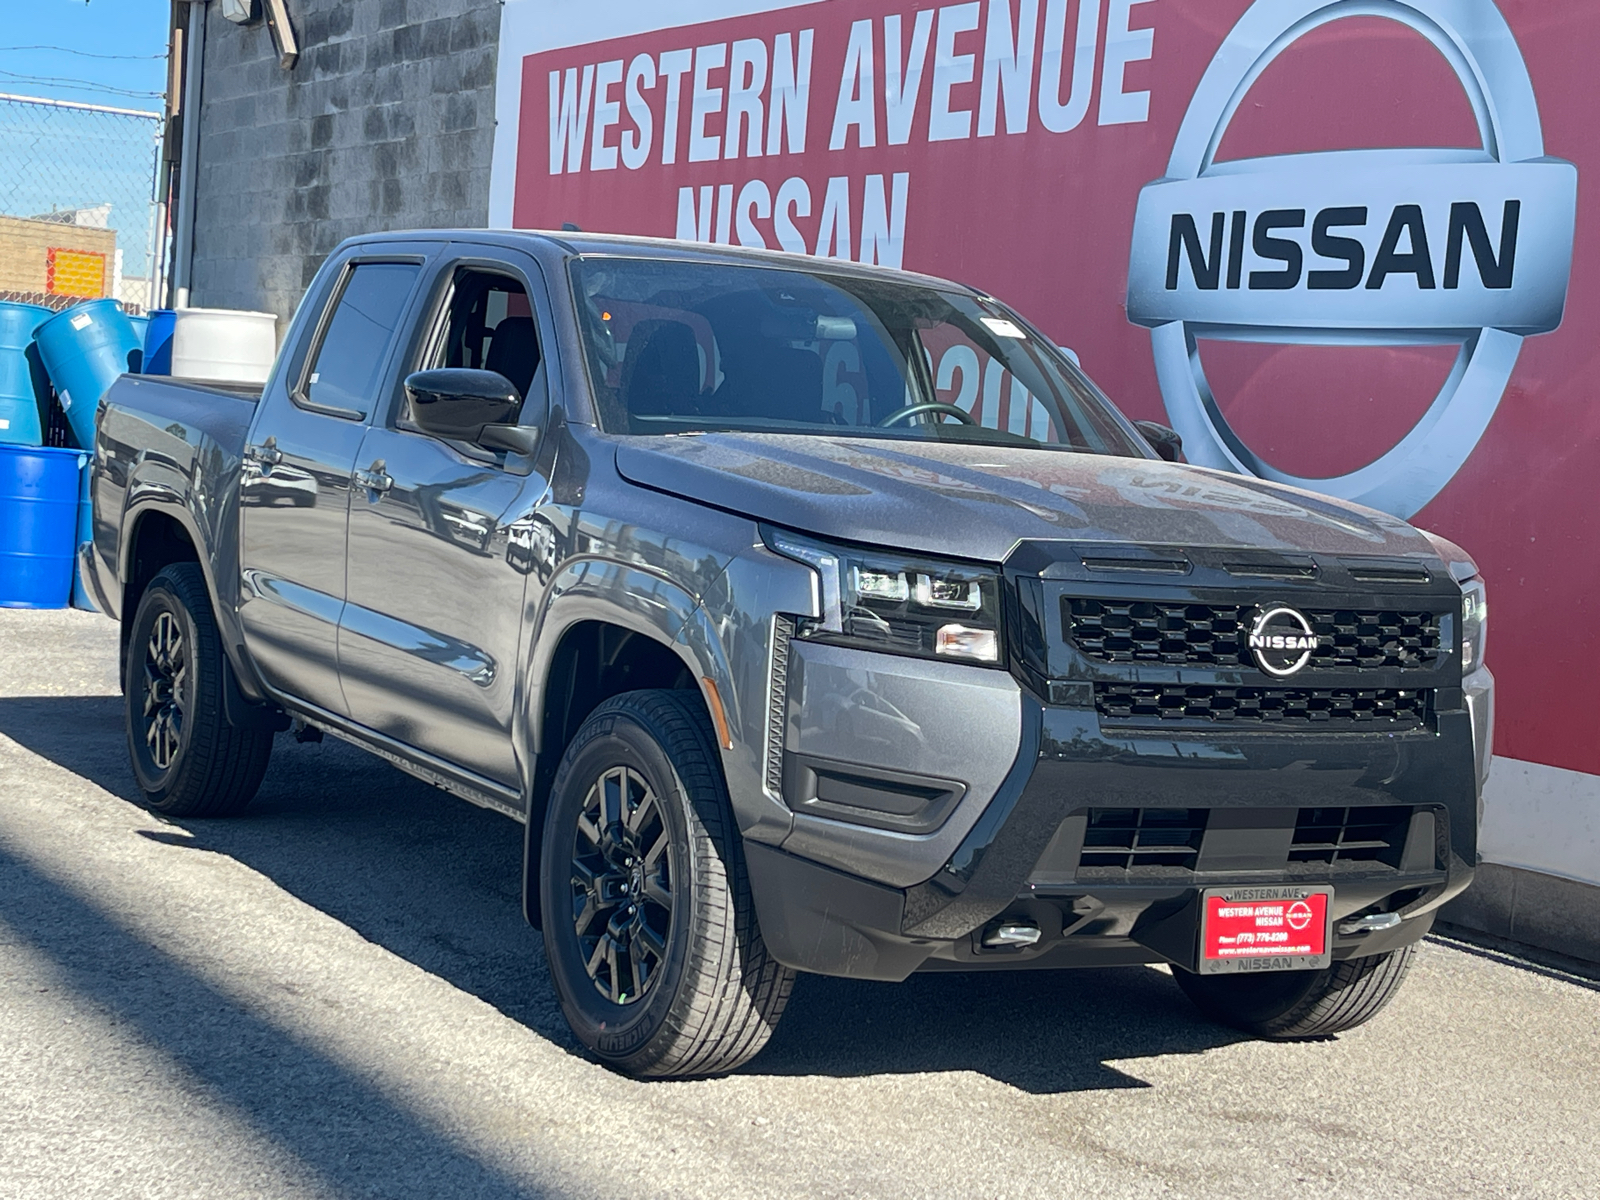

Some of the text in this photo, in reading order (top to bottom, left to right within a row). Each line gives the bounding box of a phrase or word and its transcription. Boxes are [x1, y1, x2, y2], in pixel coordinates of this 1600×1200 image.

[549, 0, 1155, 176] WESTERN AVENUE
[676, 172, 909, 270] NISSAN
[1165, 200, 1522, 290] NISSAN
[1249, 635, 1318, 649] NISSAN
[1233, 888, 1300, 900] WESTERN AVE
[1218, 906, 1284, 917] WESTERN AVENUE
[1255, 917, 1284, 926] NISSAN
[1236, 934, 1254, 945] (773)
[1237, 958, 1292, 970] NISSAN
